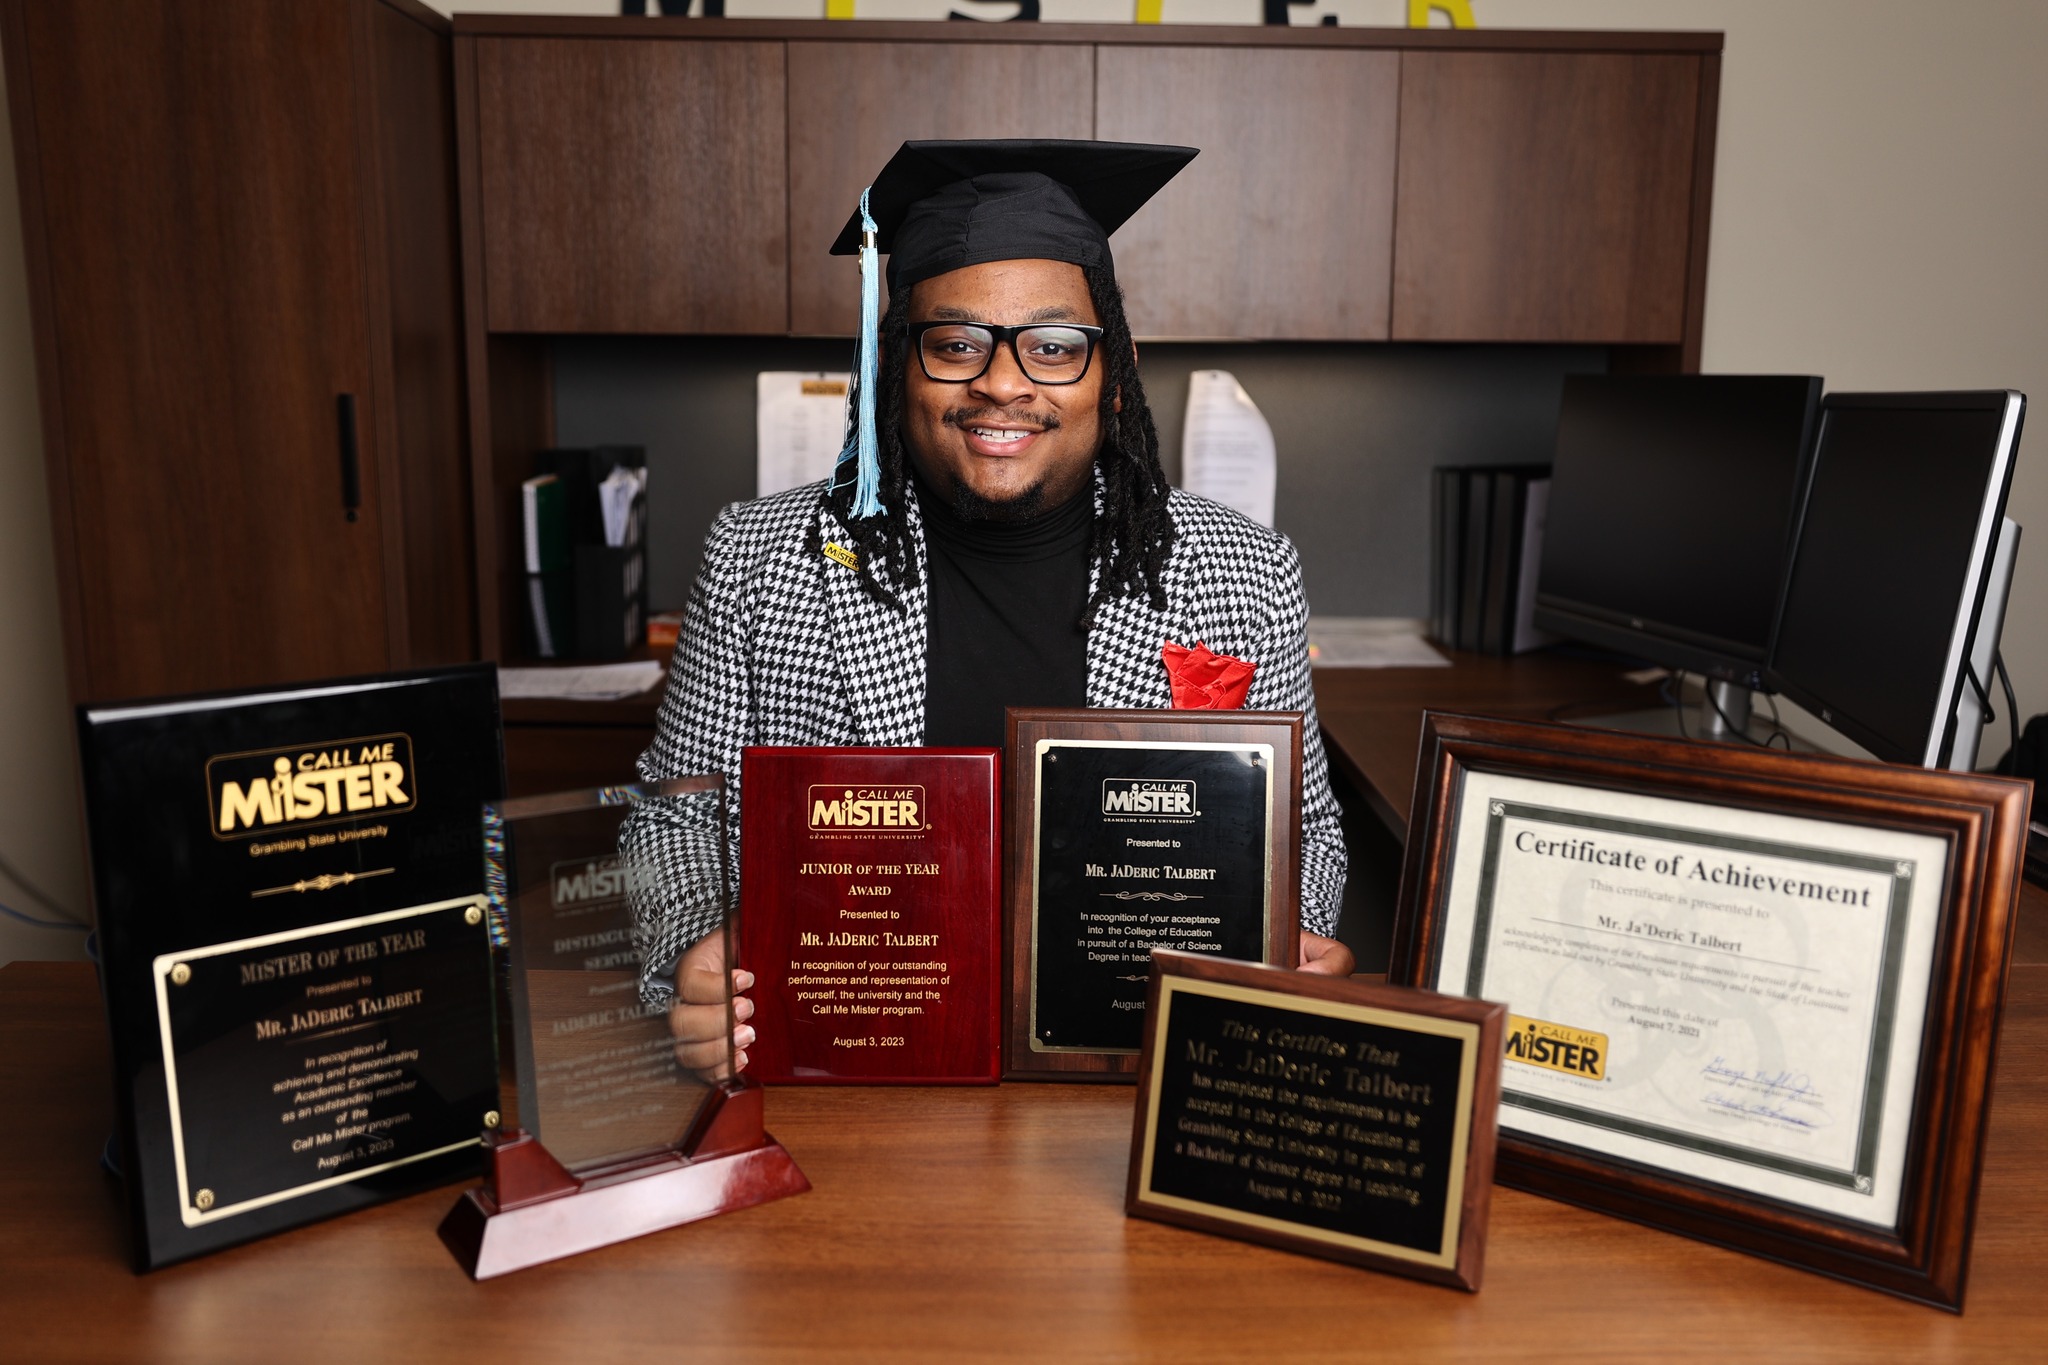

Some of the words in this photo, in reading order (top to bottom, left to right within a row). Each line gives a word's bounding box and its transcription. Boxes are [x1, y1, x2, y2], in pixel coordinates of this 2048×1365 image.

[297, 749, 352, 772] CALL
[360, 742, 394, 763] ME
[857, 790, 889, 800] CALL
[893, 790, 914, 800] ME
[1141, 783, 1167, 792] CALL
[1170, 784, 1187, 793] ME
[250, 837, 306, 857] Grambling
[308, 831, 336, 848] State
[338, 825, 389, 842] University
[1126, 838, 1171, 849] Presented
[1172, 839, 1182, 849] to
[800, 863, 853, 875] JUNIOR
[856, 864, 873, 875] OF
[876, 864, 901, 875] THE
[904, 863, 940, 875] YEAR
[1085, 864, 1107, 878] MR.
[1163, 865, 1217, 880] TALBERT
[1514, 829, 1647, 872] Certificate
[1655, 849, 1682, 875] of
[1688, 859, 1872, 909] Achievement
[848, 884, 892, 896] AWARD
[1589, 877, 1616, 893] This
[1617, 882, 1675, 905] certificate
[1677, 891, 1688, 906] is
[1690, 894, 1753, 921] presented
[1756, 905, 1770, 920] to
[839, 909, 888, 920] Presented
[890, 910, 900, 920] to
[1080, 912, 1088, 921] In
[1090, 912, 1138, 924] recognition
[1139, 913, 1149, 923] of
[1150, 915, 1169, 925] your
[1171, 915, 1221, 927] acceptance
[800, 932, 824, 946] MR.
[883, 932, 940, 946] TALBERT
[1087, 926, 1104, 935] into
[1108, 926, 1122, 936] the
[1124, 926, 1157, 937] College
[1158, 927, 1168, 937] of
[1169, 928, 1213, 938] Education
[1597, 915, 1622, 931] Mr.
[1689, 931, 1743, 953] Talbert
[317, 950, 340, 968] OF
[344, 941, 378, 963] THE
[380, 929, 427, 953] YEAR
[1077, 939, 1086, 948] in
[1087, 939, 1117, 950] pursuit
[1118, 940, 1128, 949] of
[1129, 941, 1135, 949] a
[1137, 940, 1175, 950] Bachelor
[1176, 942, 1186, 951] of
[1187, 942, 1222, 951] Science
[791, 960, 801, 970] In
[802, 960, 855, 972] recognition
[857, 960, 867, 970] of
[868, 962, 890, 972] your
[892, 960, 947, 972] outstanding
[1088, 952, 1120, 963] Degree
[1121, 953, 1130, 962] in
[1131, 953, 1150, 963] teac
[306, 977, 360, 998] Presented
[362, 975, 373, 987] to
[788, 975, 848, 987] performance
[850, 975, 868, 986] and
[870, 975, 938, 987] representation
[940, 975, 951, 986] of
[797, 990, 837, 1002] yourself,
[839, 990, 855, 1001] the
[857, 990, 902, 1002] university
[905, 990, 923, 1001] and
[925, 990, 941, 1001] the
[812, 1005, 831, 1015] Call
[833, 1005, 849, 1015] Me
[851, 1005, 880, 1015] Mister
[882, 1006, 925, 1017] program.
[1112, 1000, 1145, 1010] August
[1611, 996, 1660, 1016] Presented
[1662, 1004, 1680, 1020] this
[1682, 1011, 1706, 1024] date
[1707, 1016, 1719, 1029] of
[1628, 1014, 1665, 1031] August
[833, 1037, 867, 1048] August
[869, 1037, 878, 1047] 3,
[880, 1037, 905, 1047] 2023
[1221, 1019, 1261, 1042] This
[1356, 1041, 1401, 1068] That
[1540, 1026, 1572, 1042] CALL
[1576, 1034, 1598, 1047] ME
[305, 1057, 316, 1069] In
[318, 1043, 374, 1067] recognition
[376, 1039, 388, 1052] of
[272, 1071, 324, 1094] achieving
[326, 1066, 346, 1080] and
[348, 1049, 419, 1075] demonstrating
[1185, 1038, 1224, 1067] Mr.
[1235, 1048, 1332, 1087] JaDeric
[1342, 1066, 1433, 1106] Talbert
[294, 1082, 346, 1104] Academic
[347, 1069, 403, 1090] Excellence
[281, 1112, 296, 1124] as
[298, 1107, 312, 1120] an
[314, 1091, 374, 1116] outstanding
[376, 1080, 417, 1098] member
[335, 1112, 348, 1126] of
[351, 1108, 369, 1121] the
[291, 1137, 313, 1153] Call
[316, 1133, 333, 1147] Me
[335, 1124, 367, 1141] Mister
[317, 1151, 354, 1170] August
[369, 1139, 395, 1154] 2023
